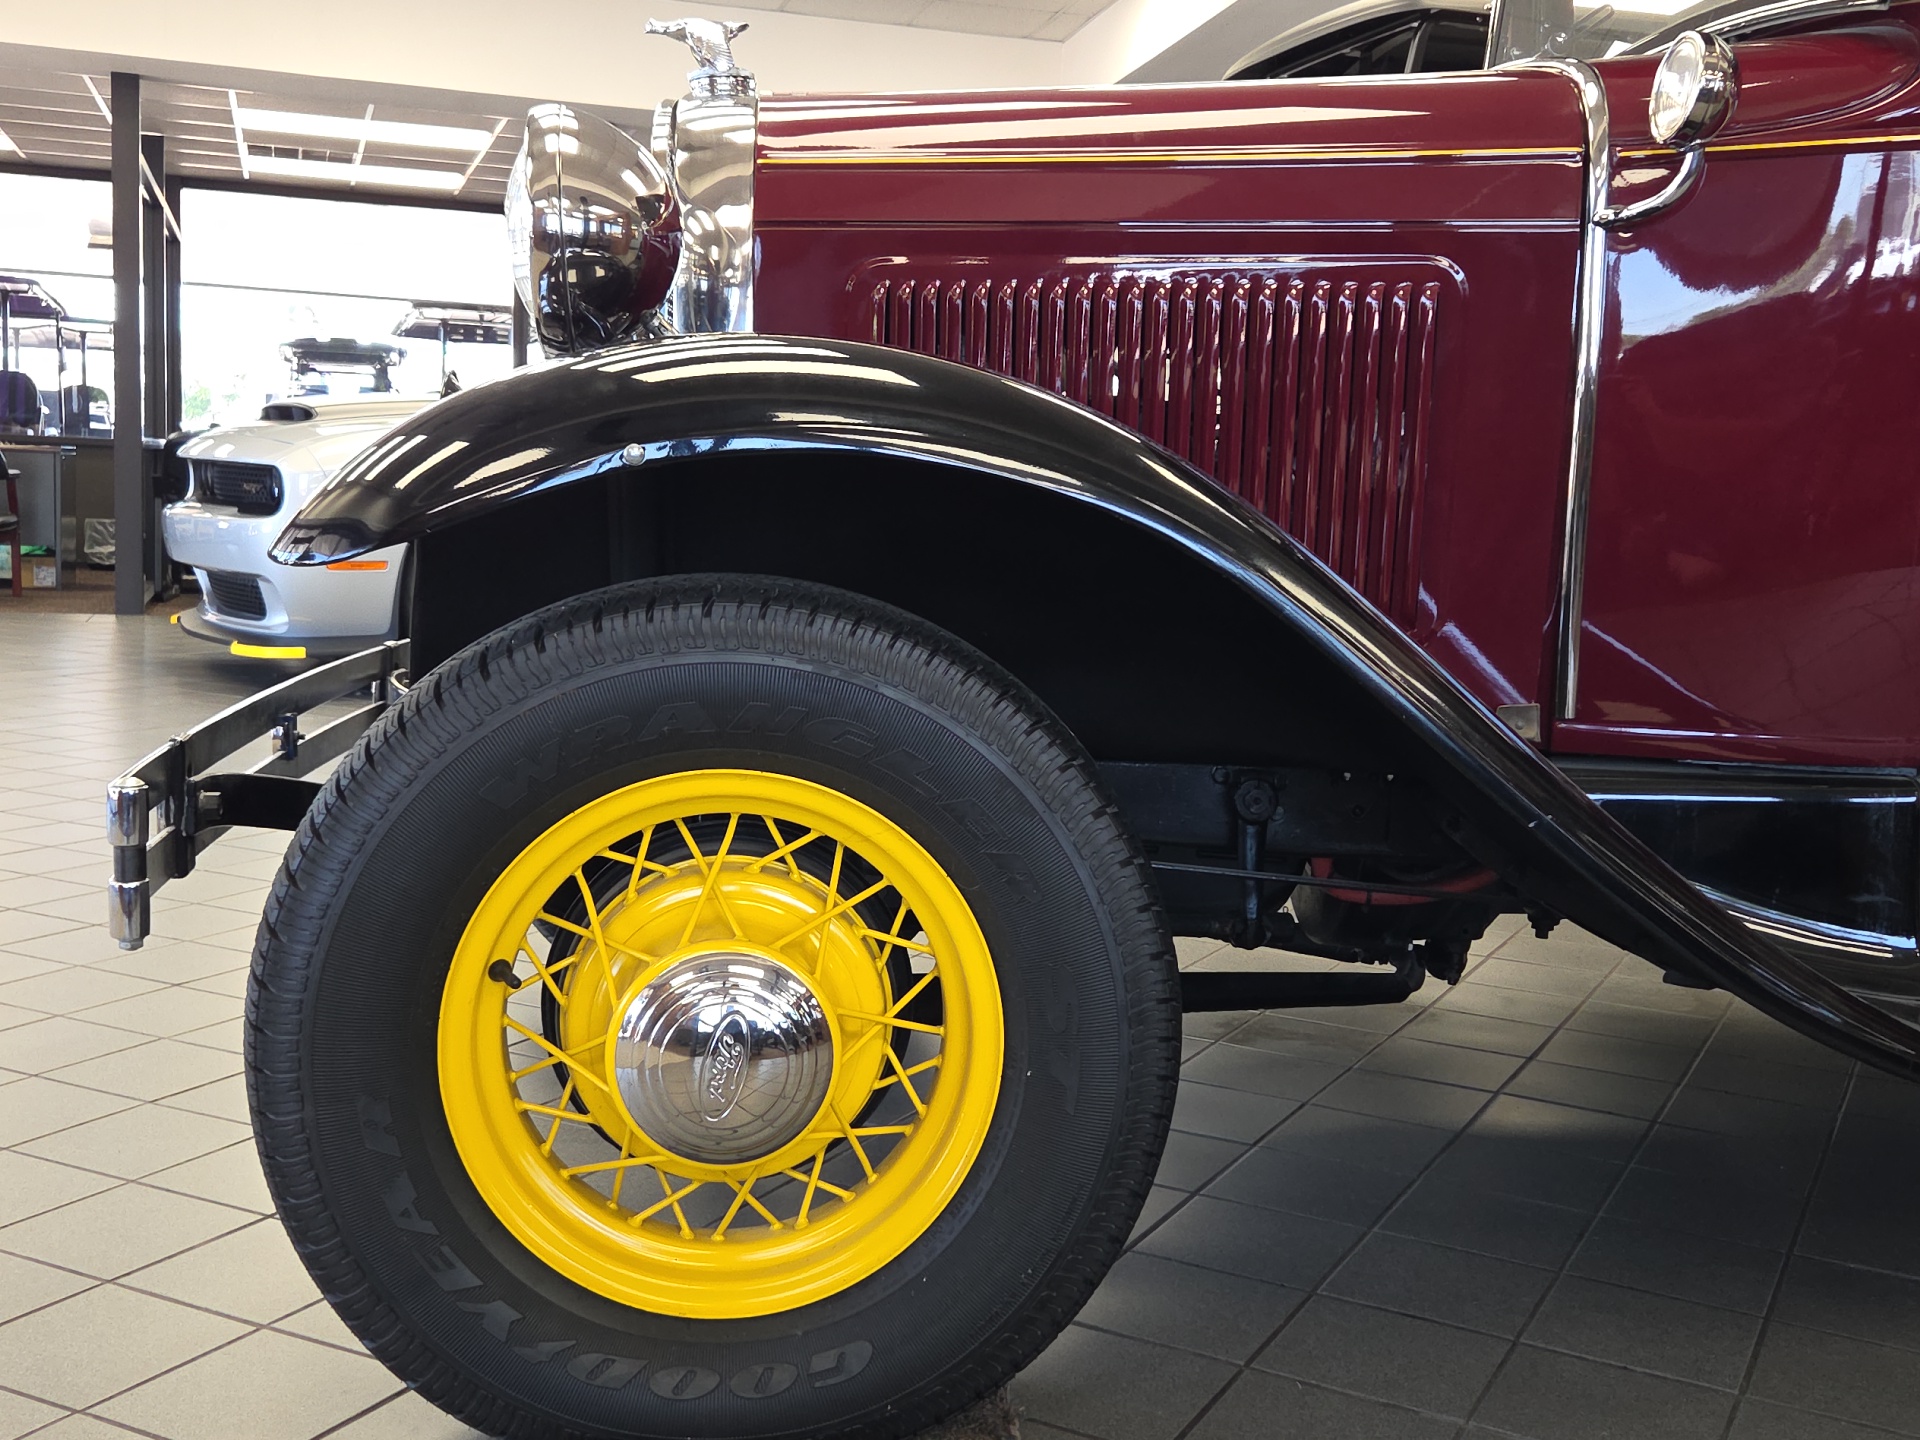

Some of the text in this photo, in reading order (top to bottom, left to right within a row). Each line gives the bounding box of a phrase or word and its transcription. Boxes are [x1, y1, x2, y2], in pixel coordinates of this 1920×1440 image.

[478, 701, 1042, 901] WRANGLER
[709, 1031, 744, 1103] Ford
[356, 1093, 874, 1400] GOODYEAR
